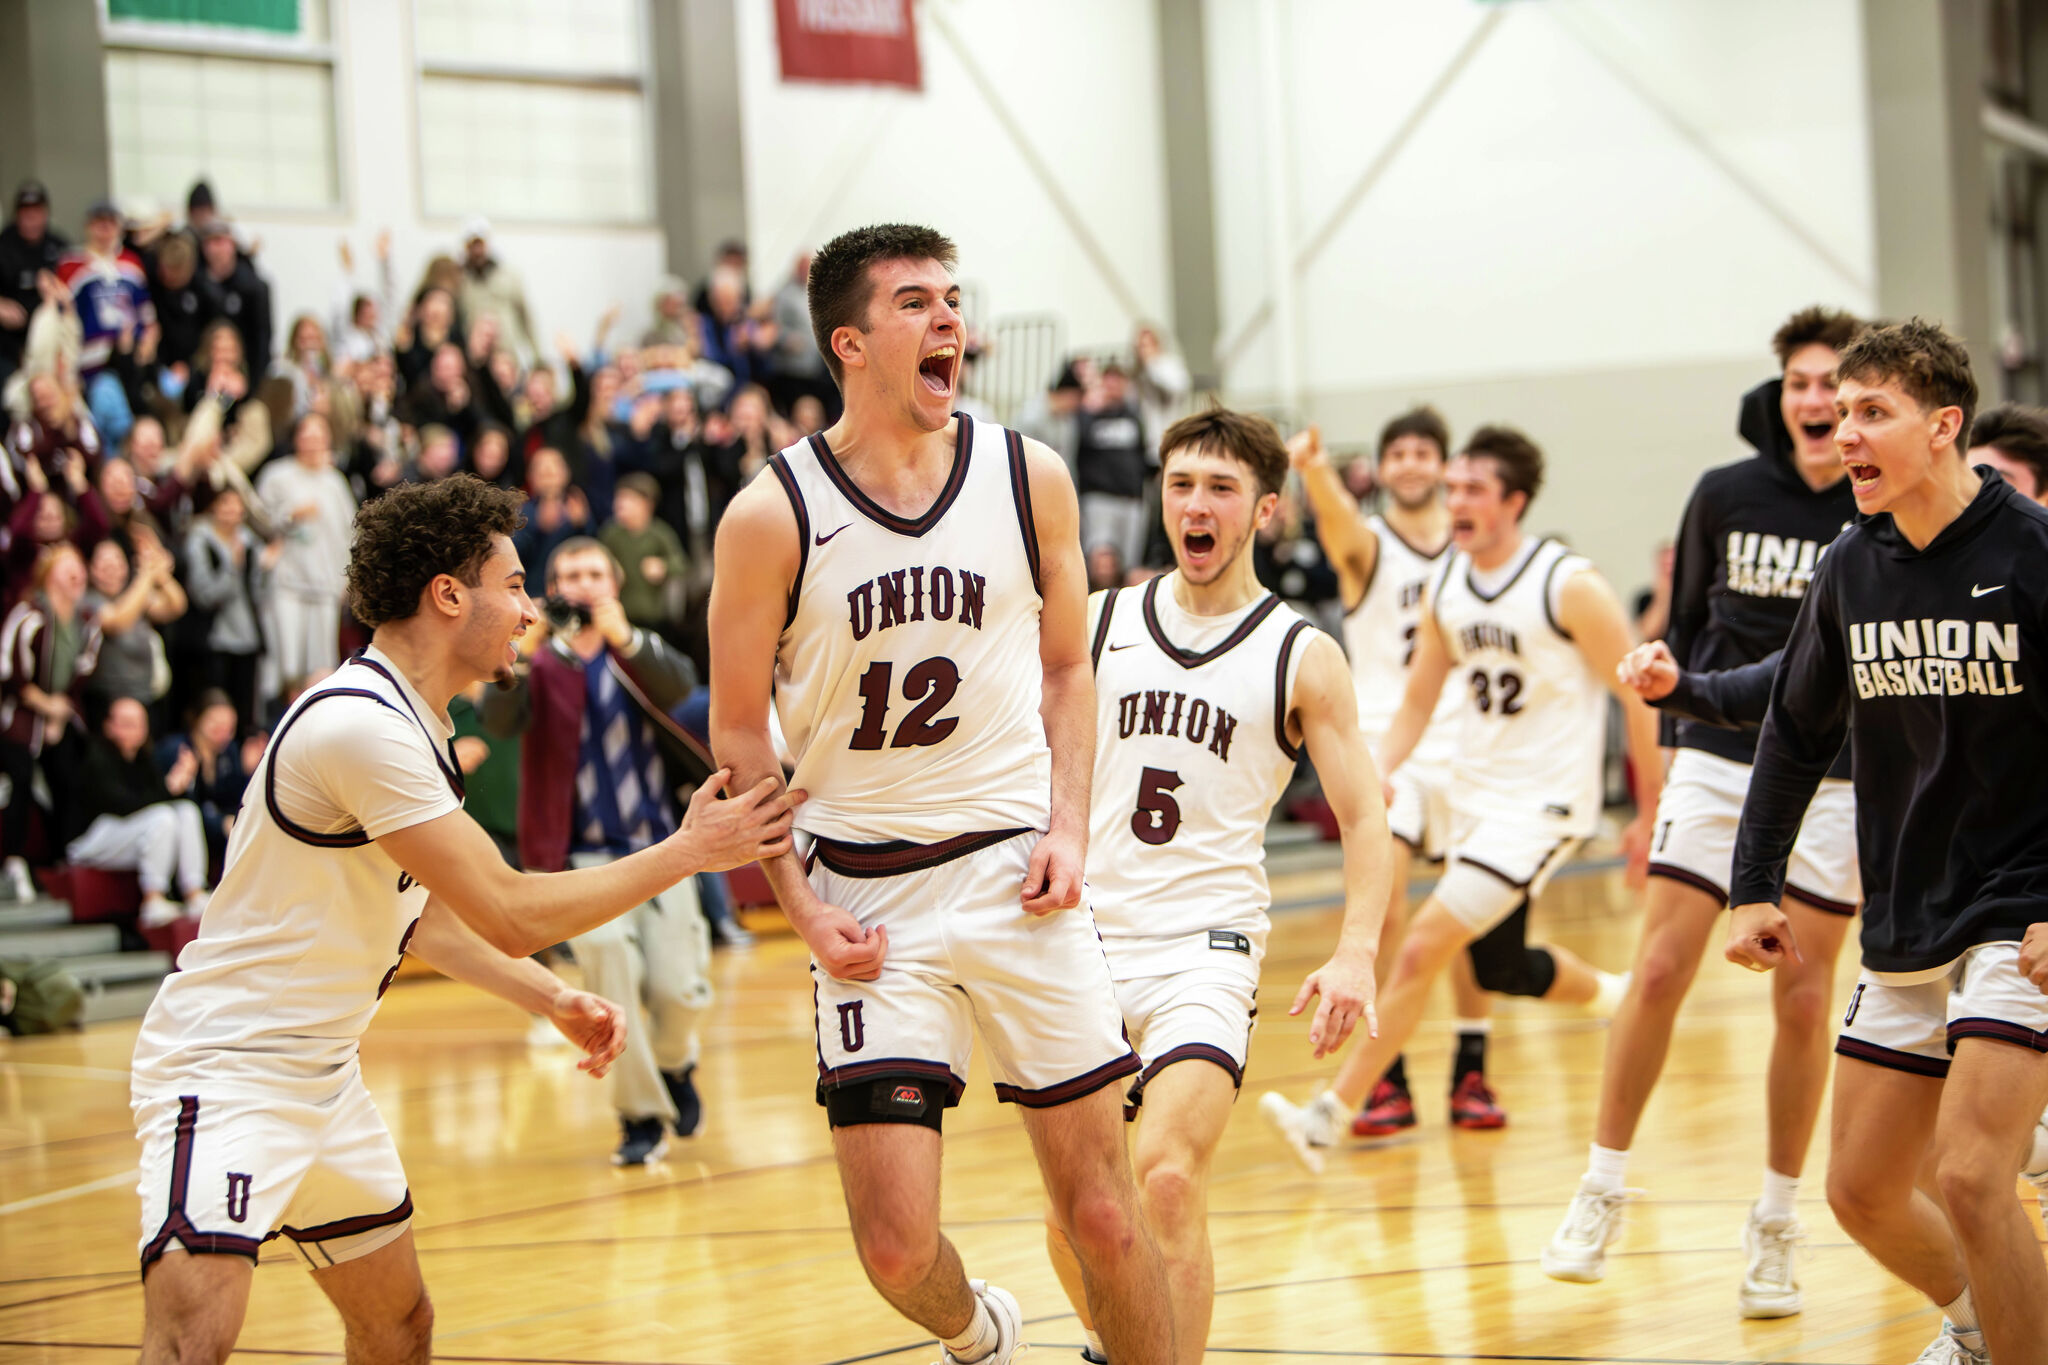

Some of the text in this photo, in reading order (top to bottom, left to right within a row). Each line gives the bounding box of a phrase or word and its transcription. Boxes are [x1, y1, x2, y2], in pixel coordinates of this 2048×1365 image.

[847, 566, 986, 642] UNION
[1727, 561, 1815, 599] BASKE
[1850, 618, 2019, 662] UNION
[848, 656, 963, 750] 12
[1471, 669, 1524, 715] 32
[1852, 657, 2024, 700] BASKETBALL
[1119, 690, 1237, 763] UNION
[1131, 766, 1185, 845] 5
[836, 999, 866, 1053] U
[226, 1171, 253, 1223] U
